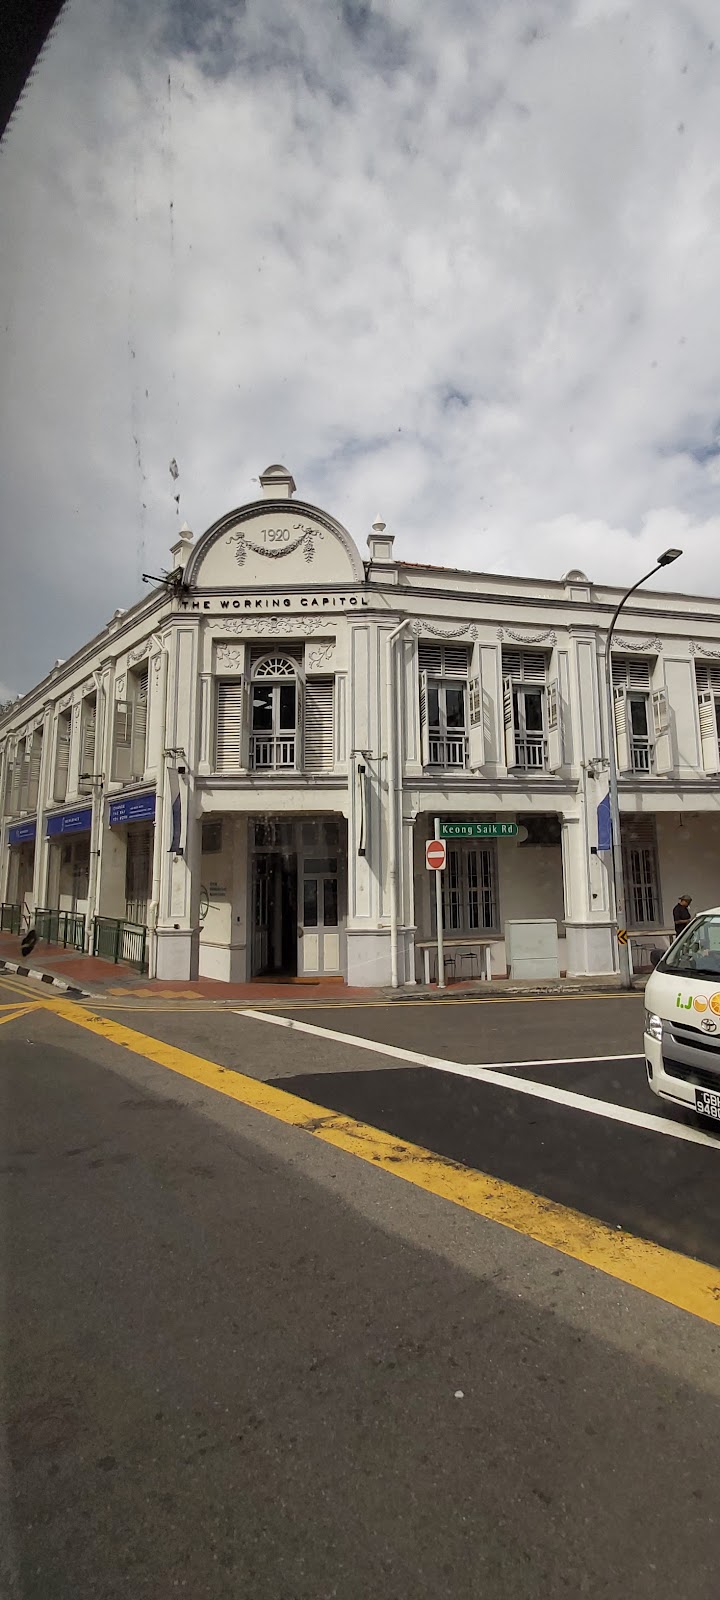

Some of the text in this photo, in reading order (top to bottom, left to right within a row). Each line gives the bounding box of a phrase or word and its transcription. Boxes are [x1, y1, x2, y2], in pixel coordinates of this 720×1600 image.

[260, 529, 291, 543] 1920
[181, 597, 369, 610] THE WORKING CAPITOL
[442, 824, 513, 836] Keong Saik Rd
